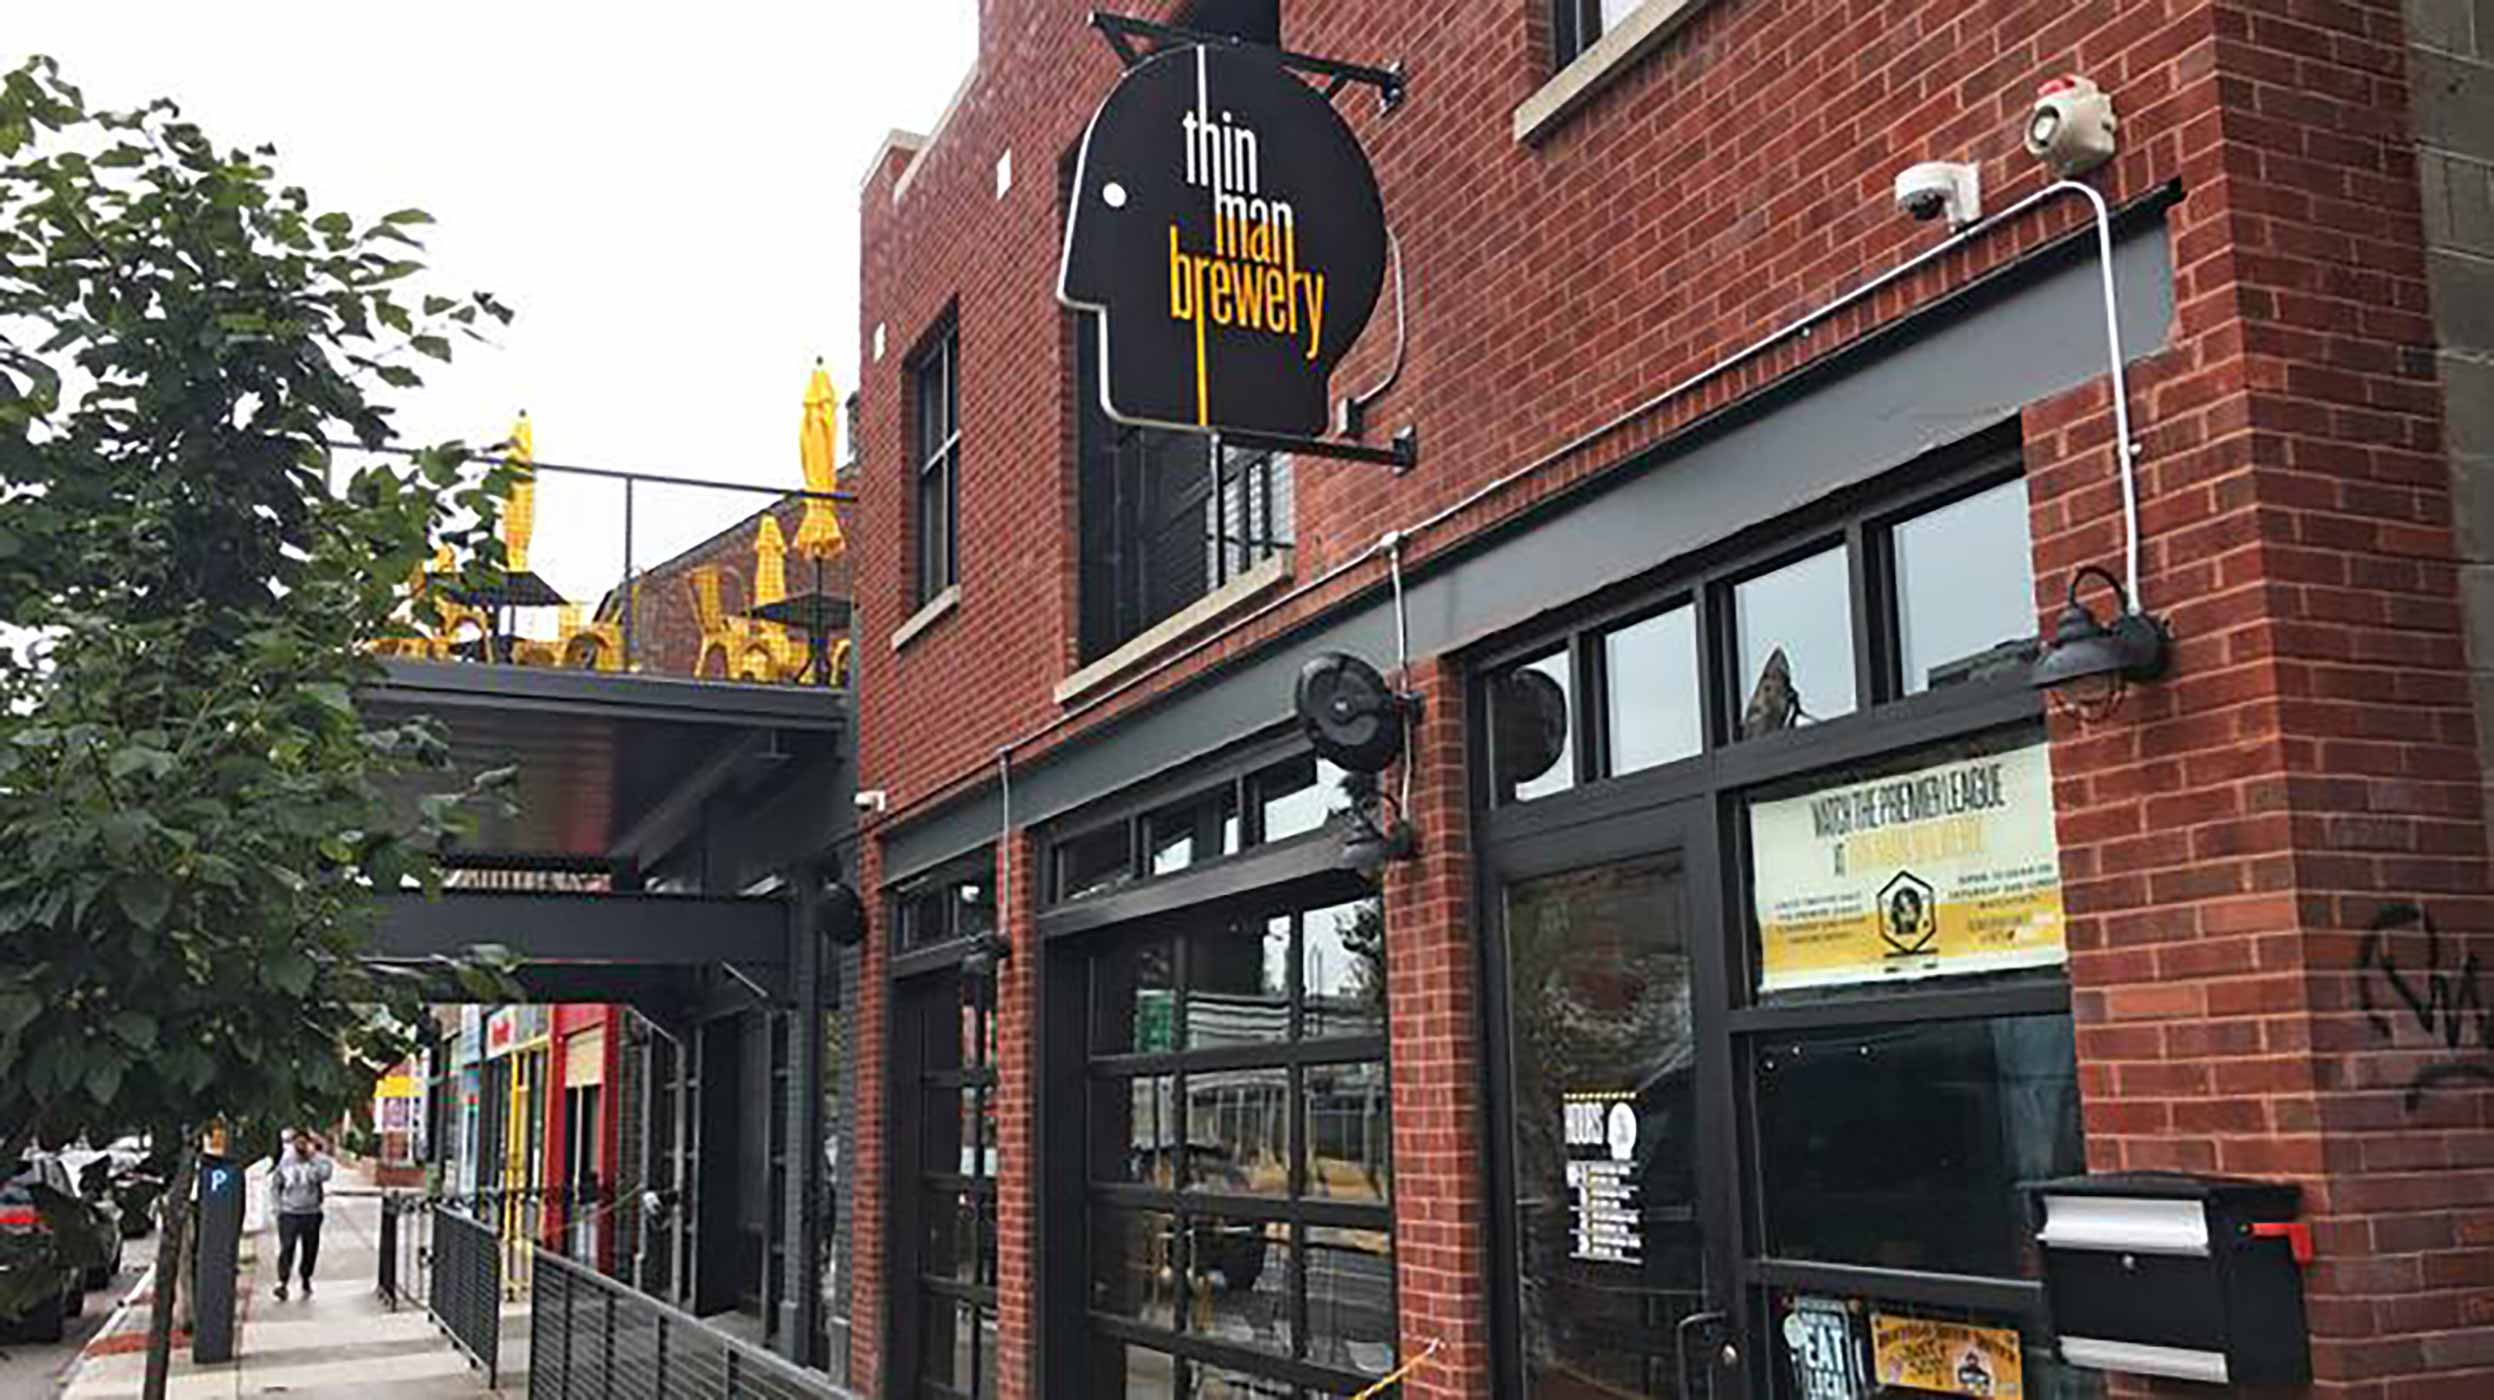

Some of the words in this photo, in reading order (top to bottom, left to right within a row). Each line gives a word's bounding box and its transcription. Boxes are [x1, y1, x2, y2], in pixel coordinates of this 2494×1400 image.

[1183, 109, 1259, 195] thin
[1214, 192, 1294, 267] man
[1169, 224, 1325, 360] brewery
[1804, 1323, 1845, 1373] EAT
